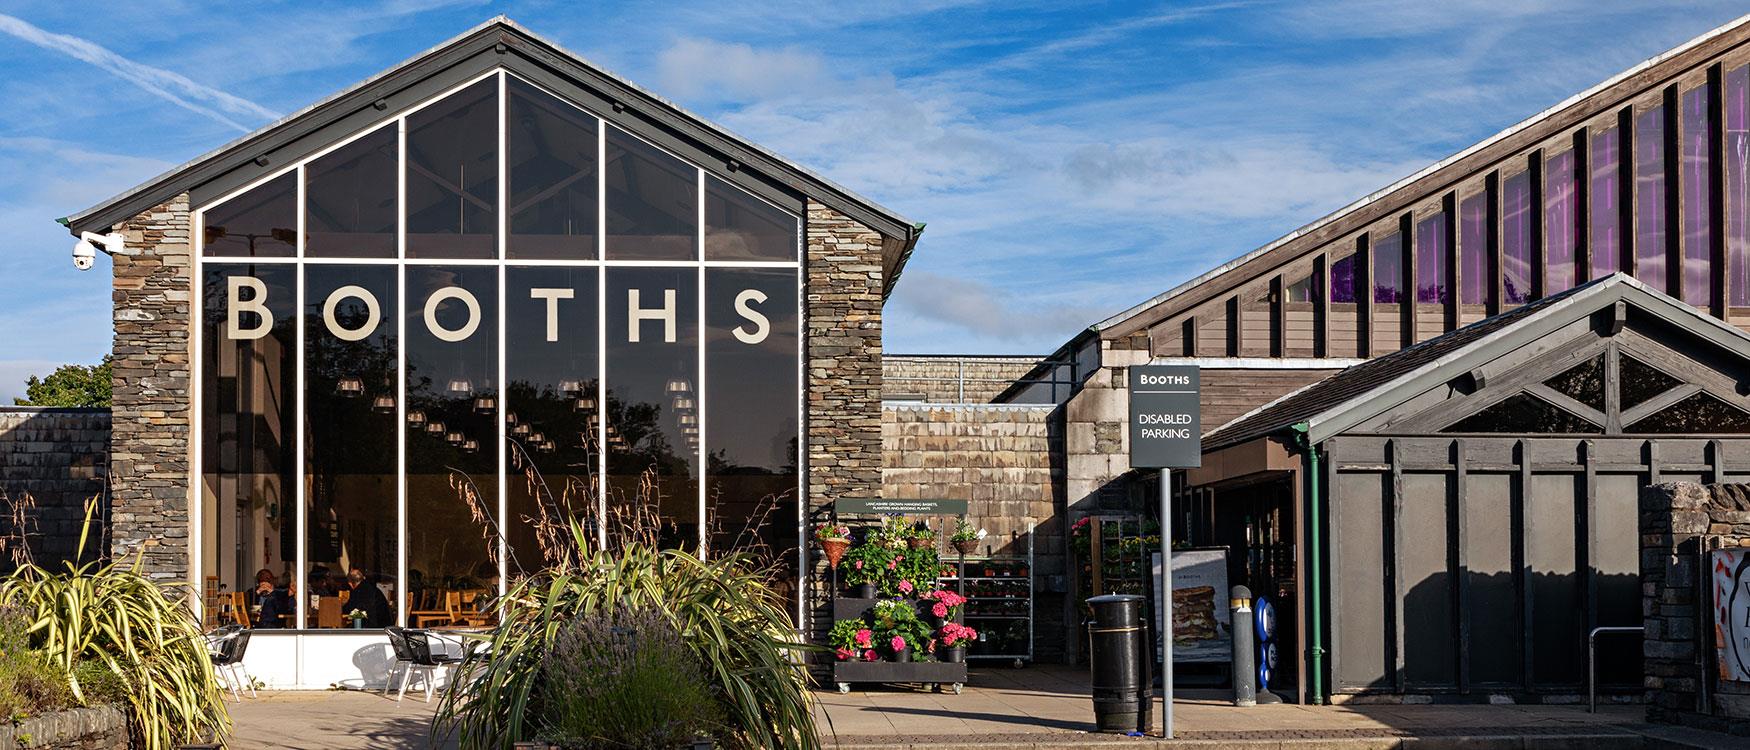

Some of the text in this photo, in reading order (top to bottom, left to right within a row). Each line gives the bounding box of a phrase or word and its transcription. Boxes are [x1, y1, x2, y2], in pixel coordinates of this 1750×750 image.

[227, 275, 770, 345] BOOTHS
[1140, 374, 1190, 385] BOOTHS
[1139, 414, 1192, 425] DISABLED
[1141, 428, 1190, 439] PARKING
